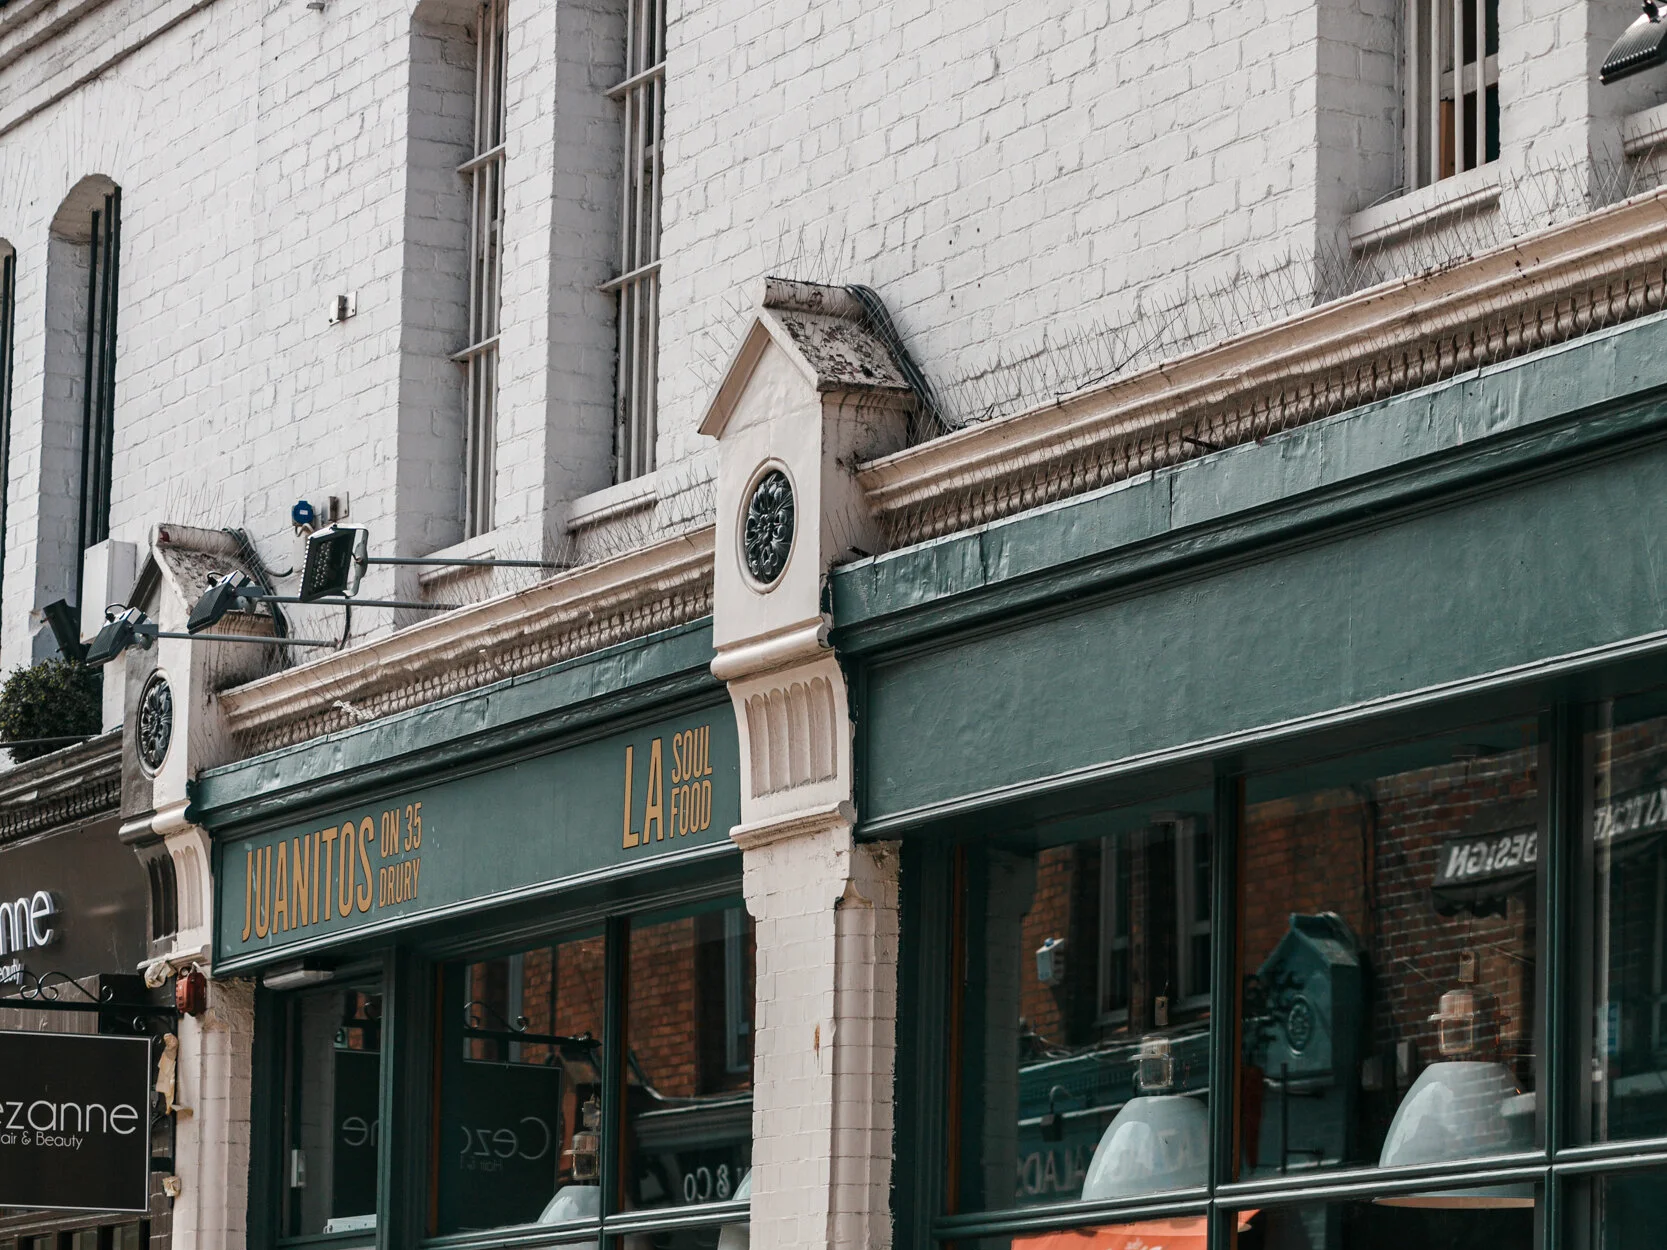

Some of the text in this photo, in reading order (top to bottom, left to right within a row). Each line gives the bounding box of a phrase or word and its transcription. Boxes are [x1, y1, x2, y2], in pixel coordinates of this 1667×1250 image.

[671, 725, 713, 783] SOUL
[621, 738, 664, 849] LA
[669, 779, 712, 838] FOOD
[380, 801, 422, 857] ON 35
[241, 815, 375, 943] JUANITOS
[378, 856, 420, 908] DRURY
[21, 1130, 31, 1146] &
[35, 1131, 83, 1150] Beauty
